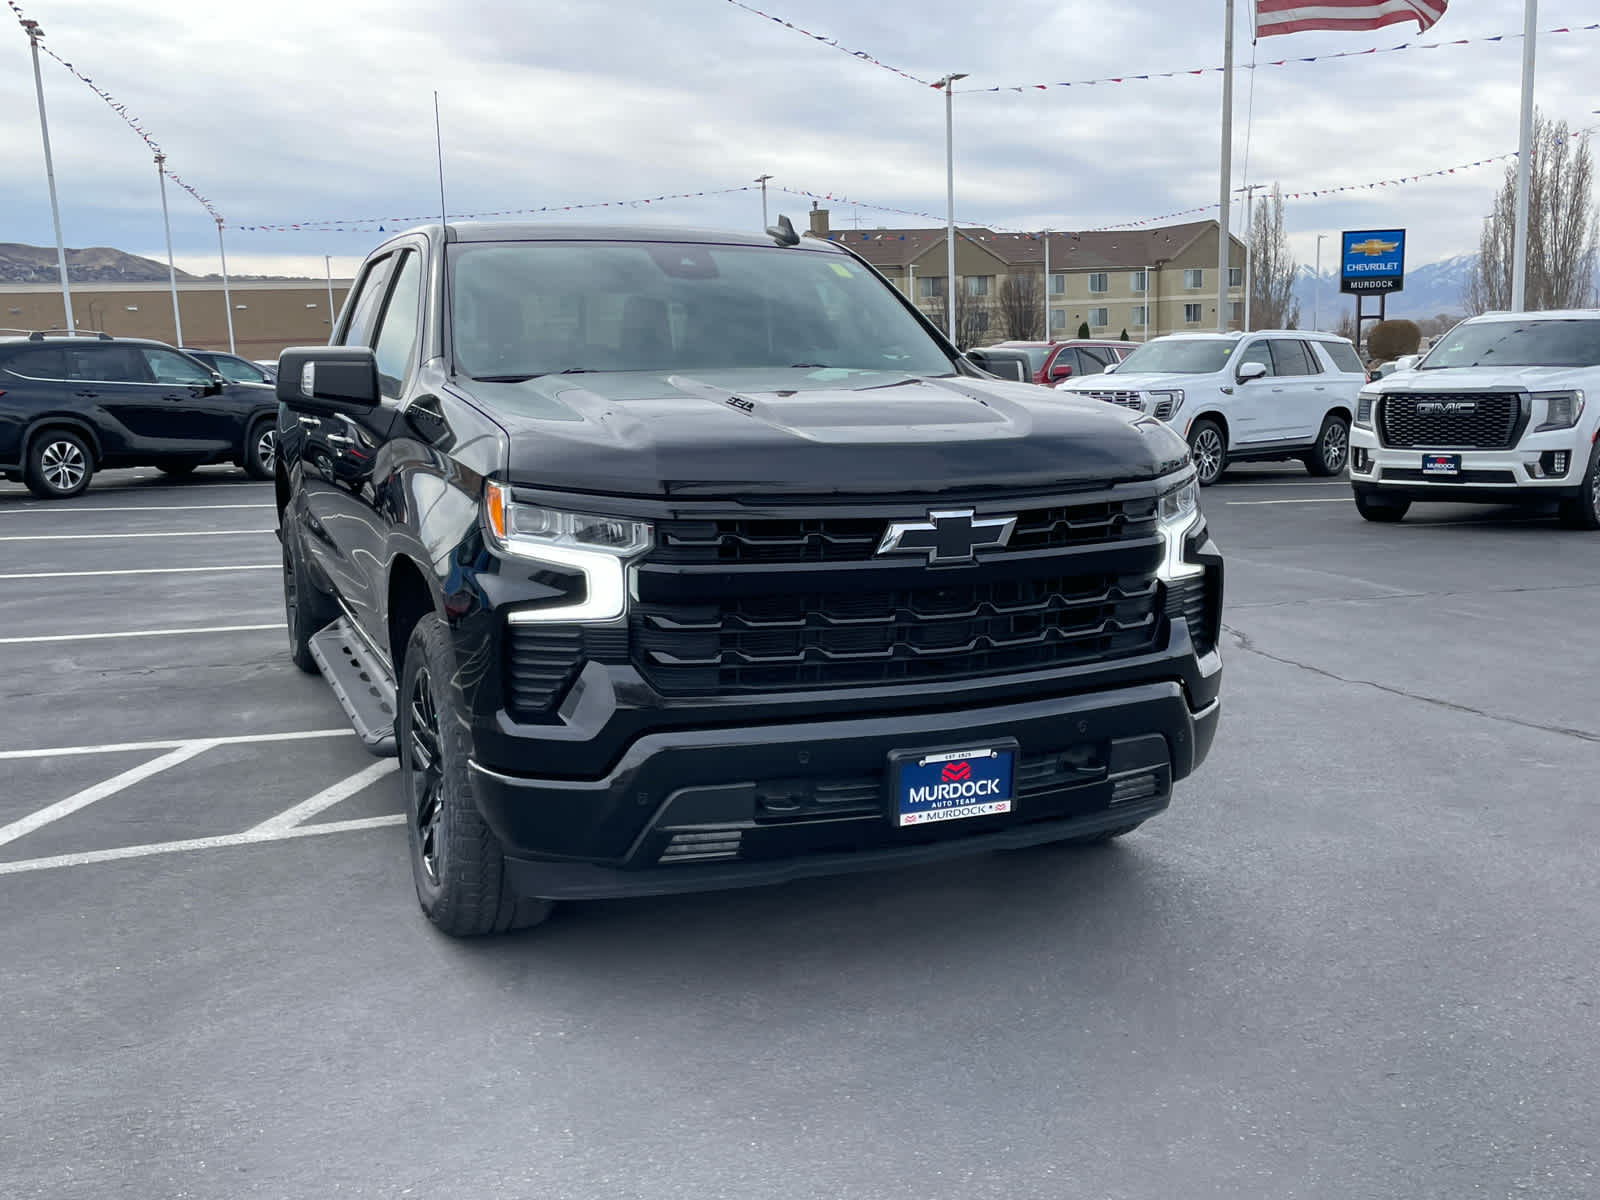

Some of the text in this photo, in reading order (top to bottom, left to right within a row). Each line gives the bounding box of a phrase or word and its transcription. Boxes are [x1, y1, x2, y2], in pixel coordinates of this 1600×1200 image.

[1346, 262, 1398, 271] CHEVROLET
[1350, 280, 1393, 288] MURDOCK
[1416, 402, 1476, 414] GMC
[909, 779, 1000, 803] MURDOCK
[931, 797, 976, 809] AUTO TEAM
[926, 806, 986, 821] MURDOCK
